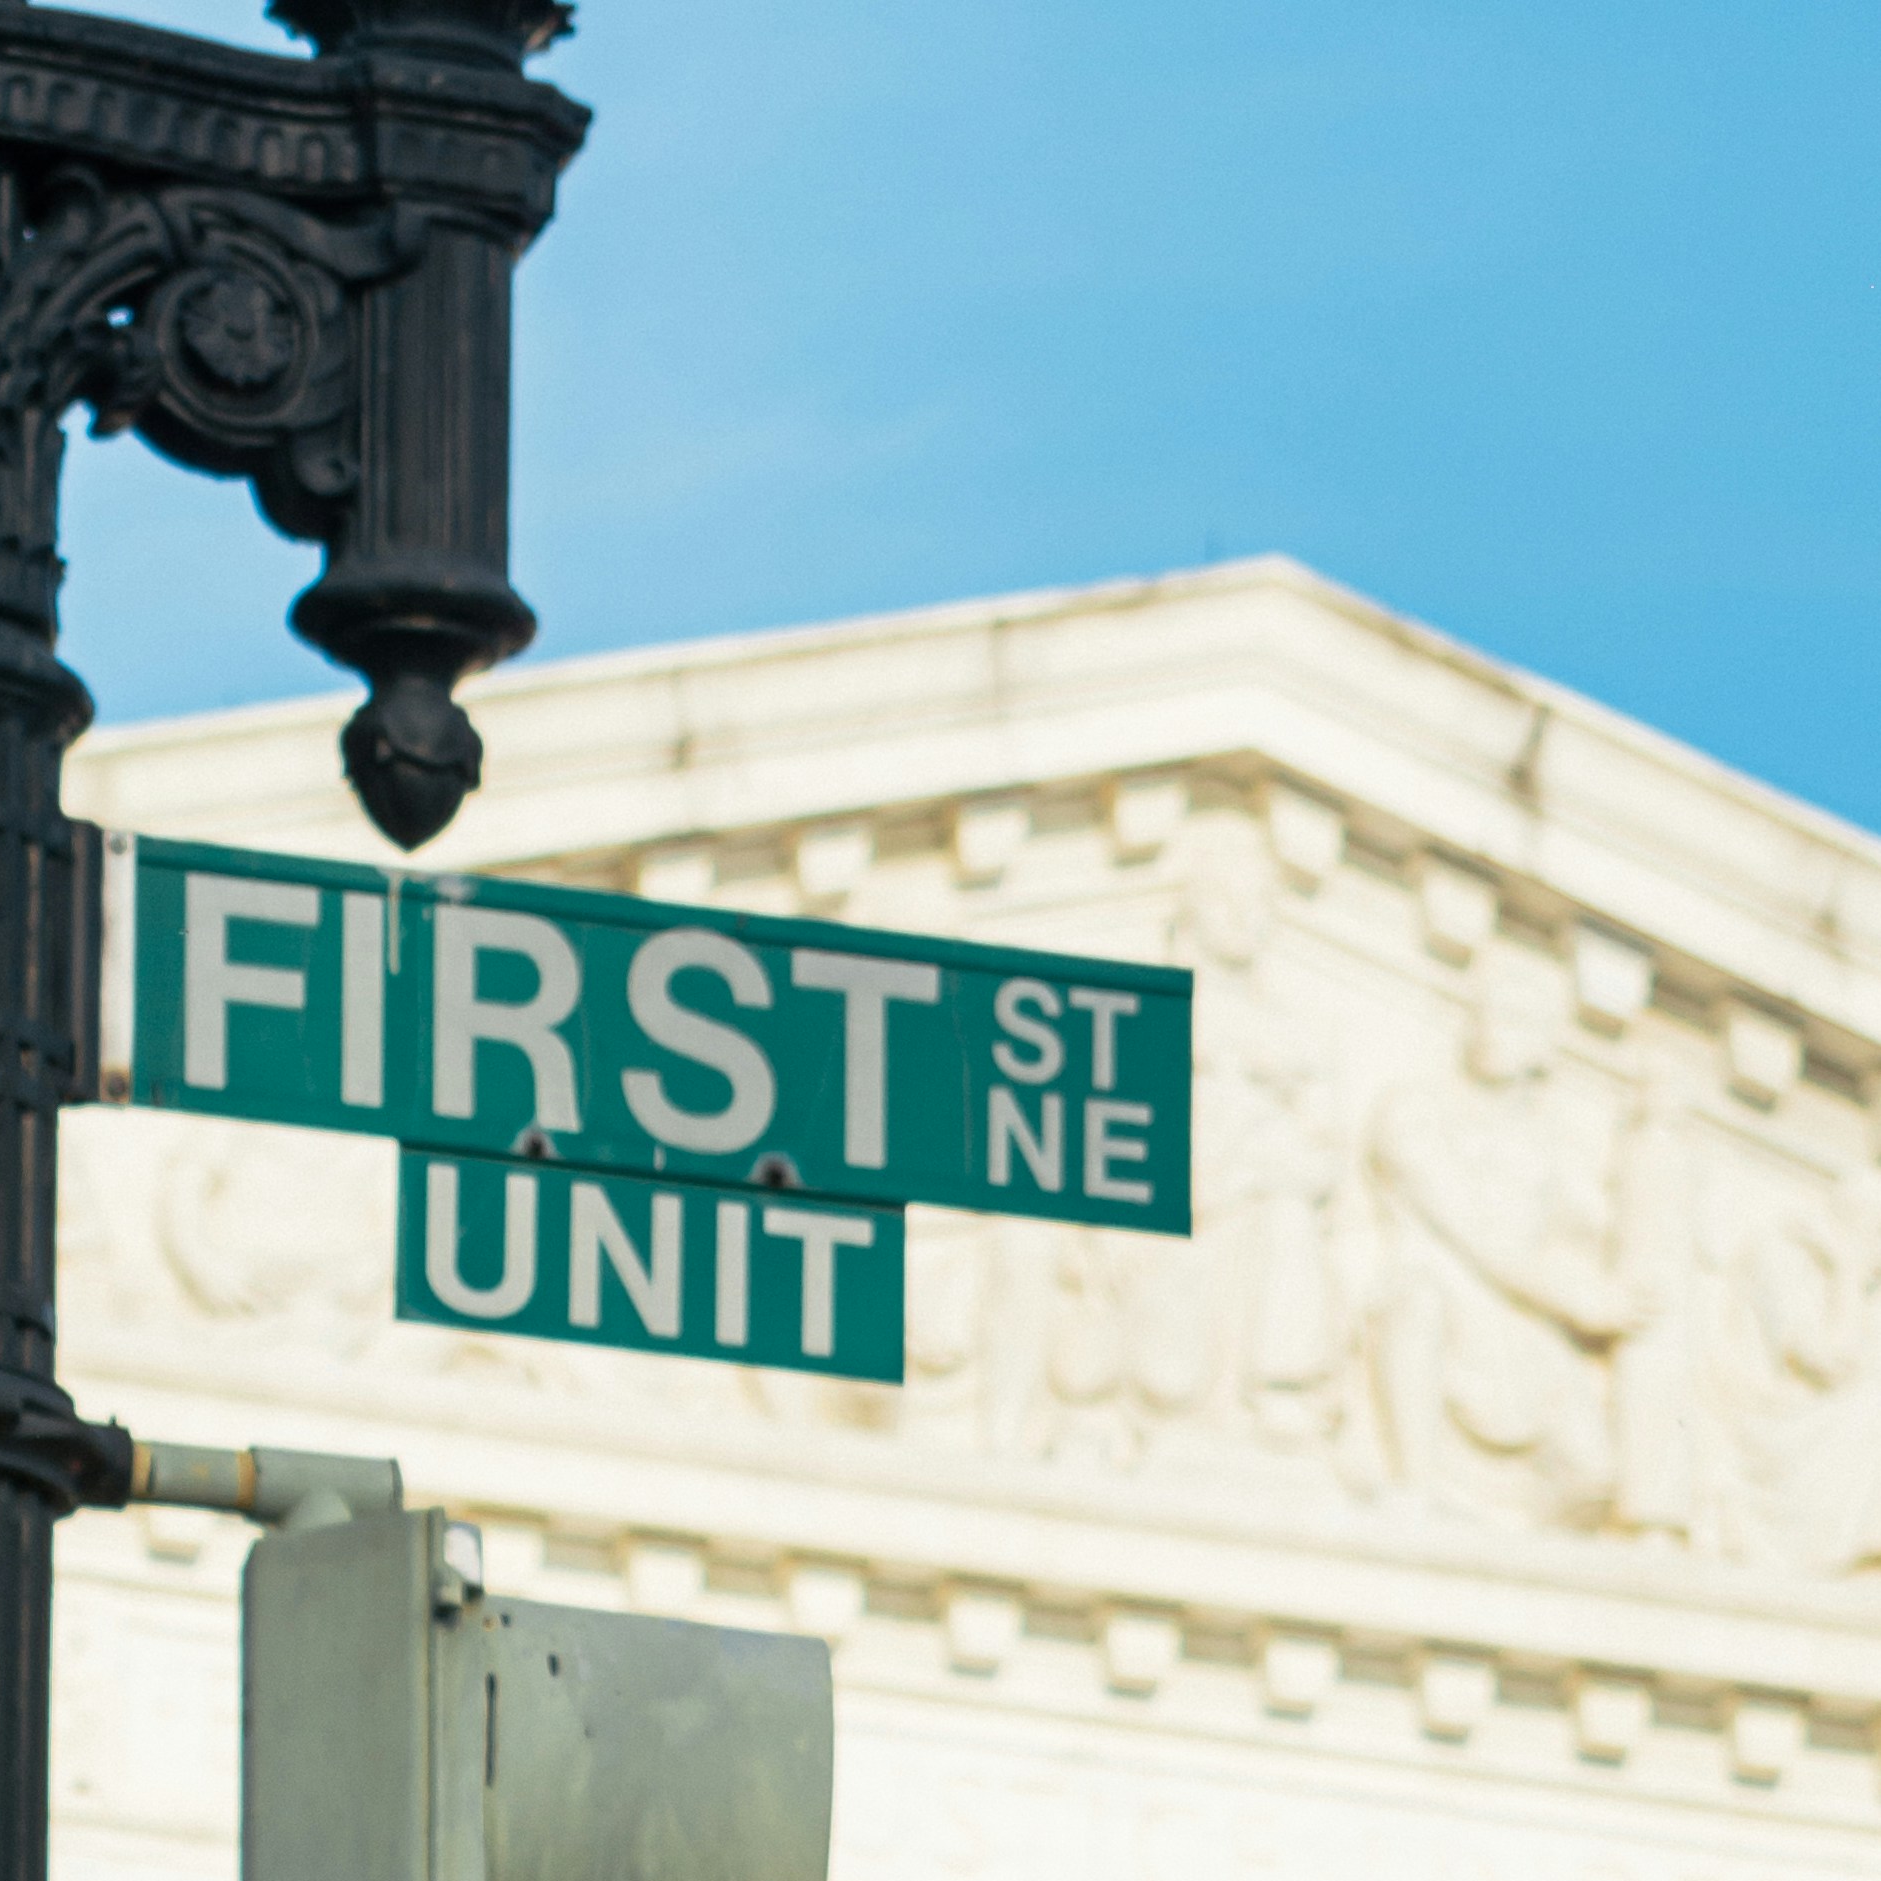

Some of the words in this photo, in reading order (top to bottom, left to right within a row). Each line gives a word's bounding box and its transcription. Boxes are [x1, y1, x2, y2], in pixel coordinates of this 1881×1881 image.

[183, 872, 941, 1169] FIRST
[991, 978, 1140, 1091] ST
[987, 1087, 1155, 1203] NE
[425, 1163, 875, 1358] UNIT
